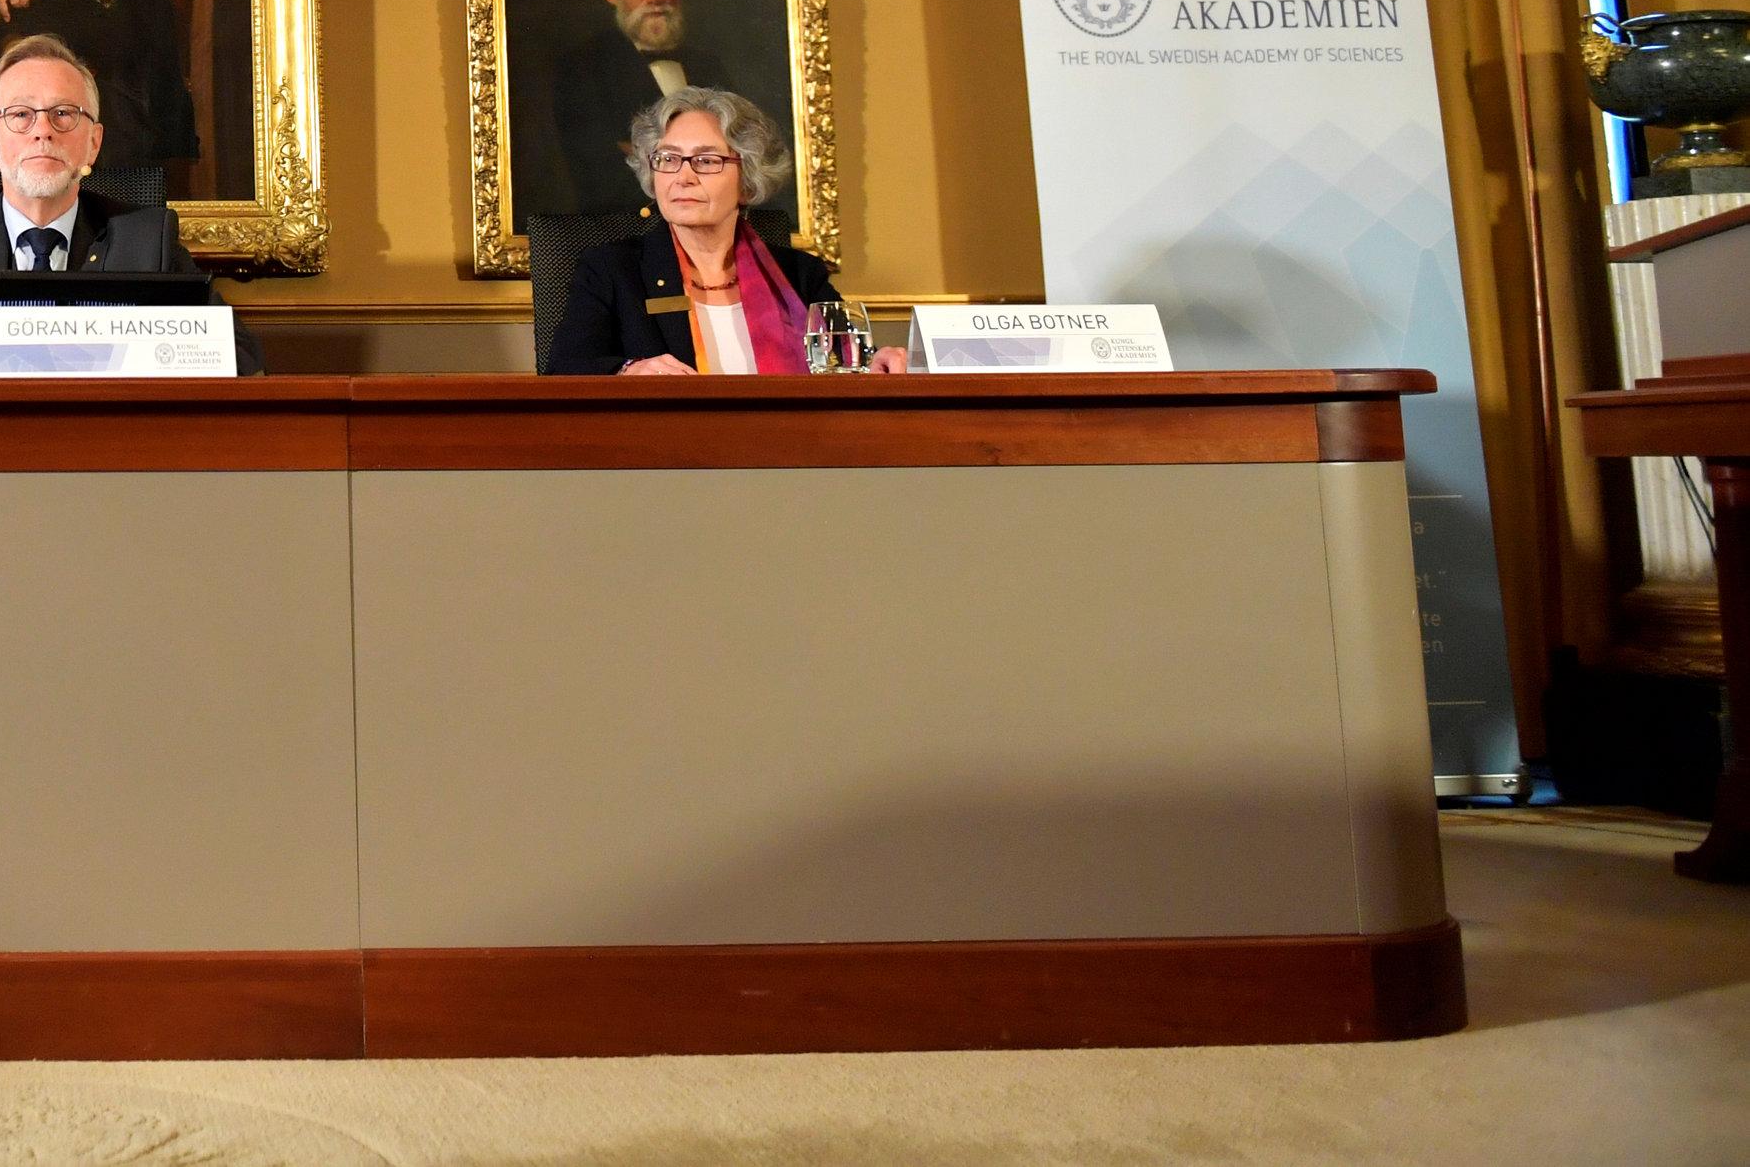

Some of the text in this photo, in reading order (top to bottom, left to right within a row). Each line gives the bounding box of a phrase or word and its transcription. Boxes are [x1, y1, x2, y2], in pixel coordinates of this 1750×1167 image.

[1173, 0, 1399, 30] AKADEMIEN
[1059, 46, 1405, 66] THE ROYAL SWEDISH ACADEMY OF SCIENCES
[7, 317, 208, 337] GÖRAN K. HANSSON
[972, 314, 1109, 331] OLGA BOTNER
